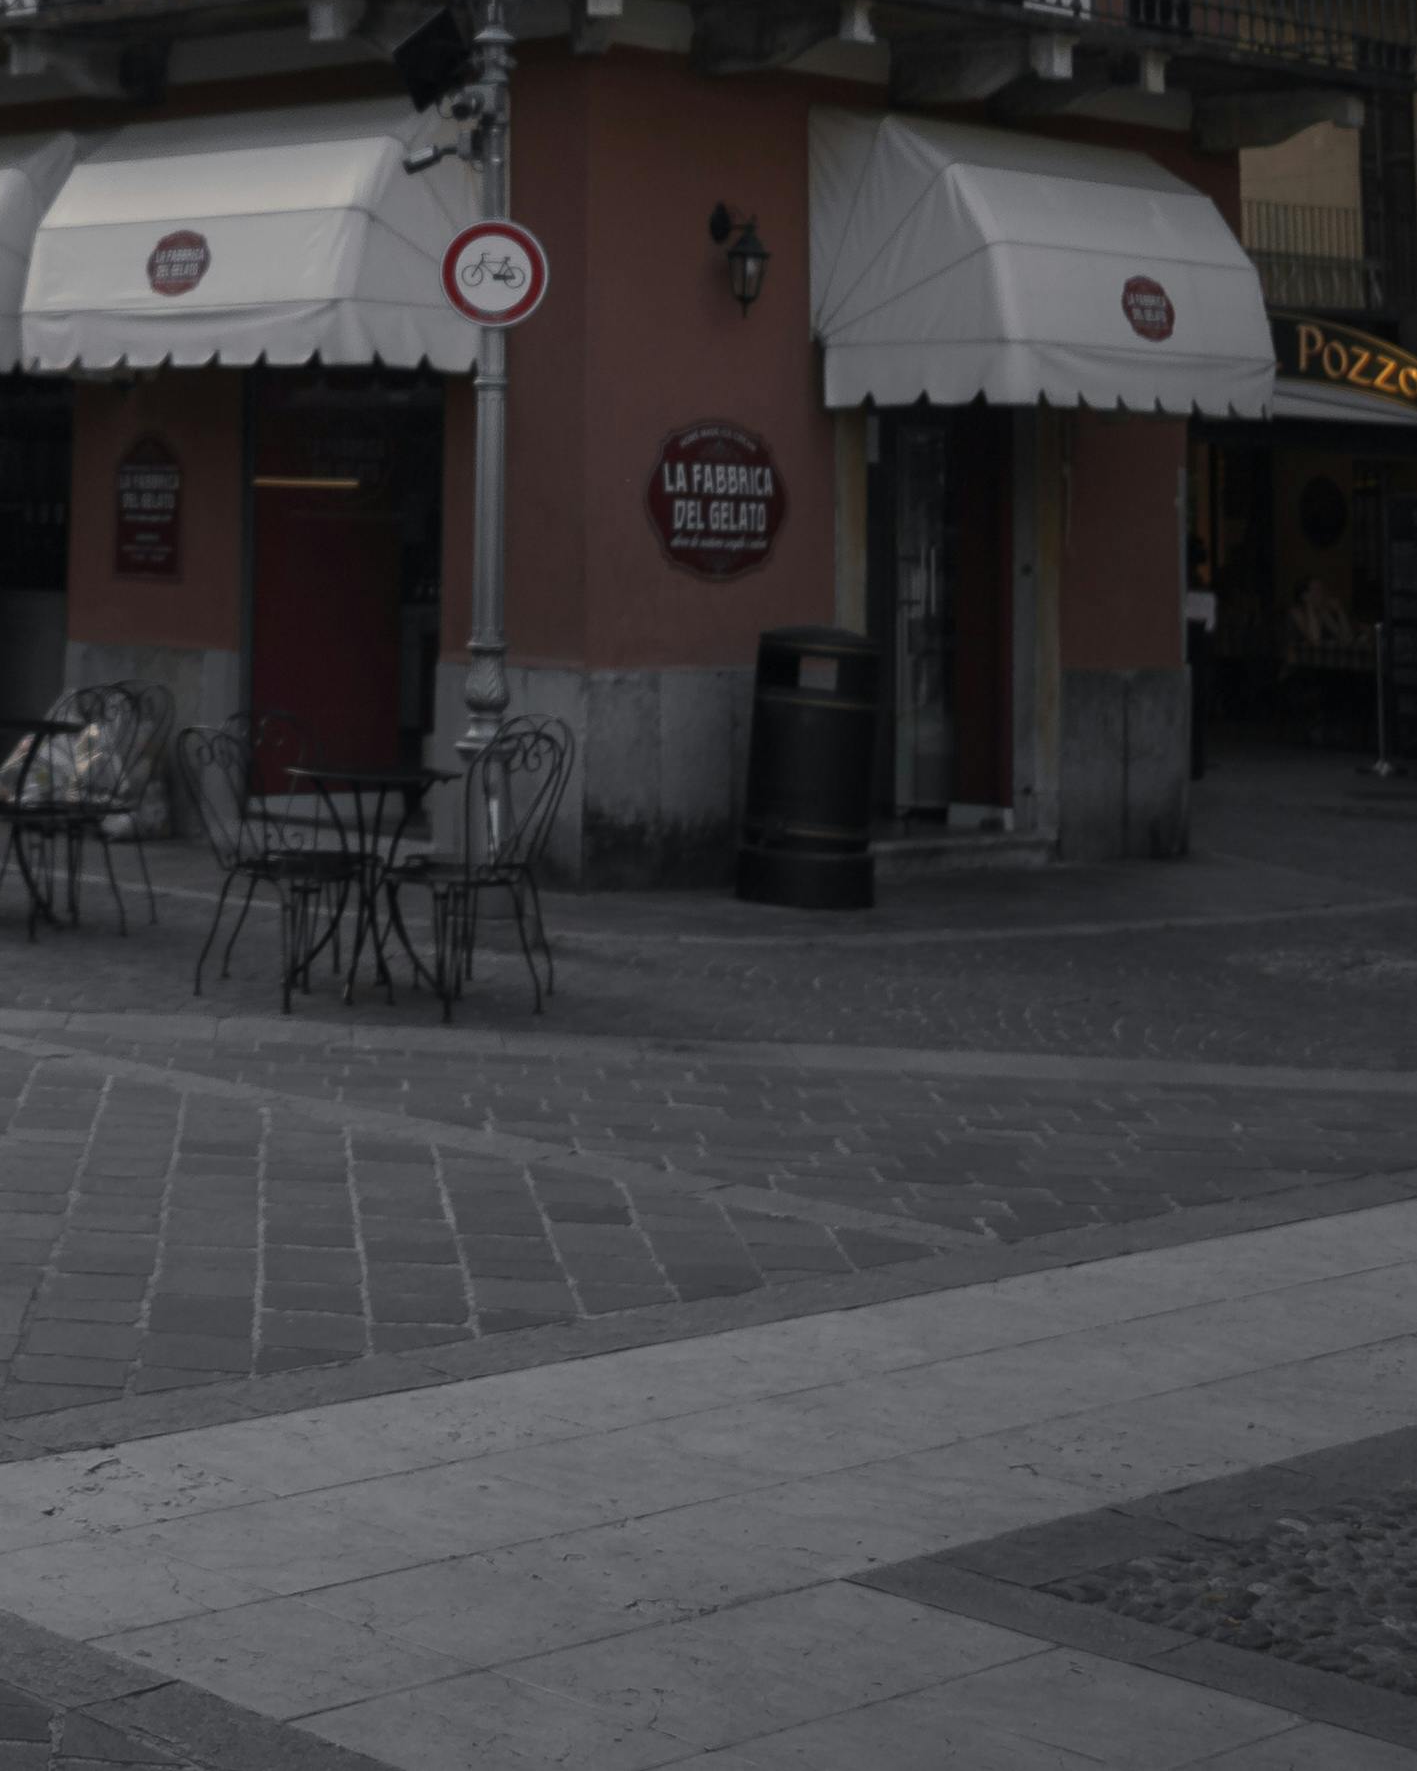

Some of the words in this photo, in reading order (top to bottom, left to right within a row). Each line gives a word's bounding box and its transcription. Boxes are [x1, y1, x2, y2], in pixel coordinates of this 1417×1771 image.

[664, 462, 688, 493] LA
[692, 463, 773, 497] FABBRICA
[674, 499, 705, 530] DEL
[710, 501, 767, 531] GELATO
